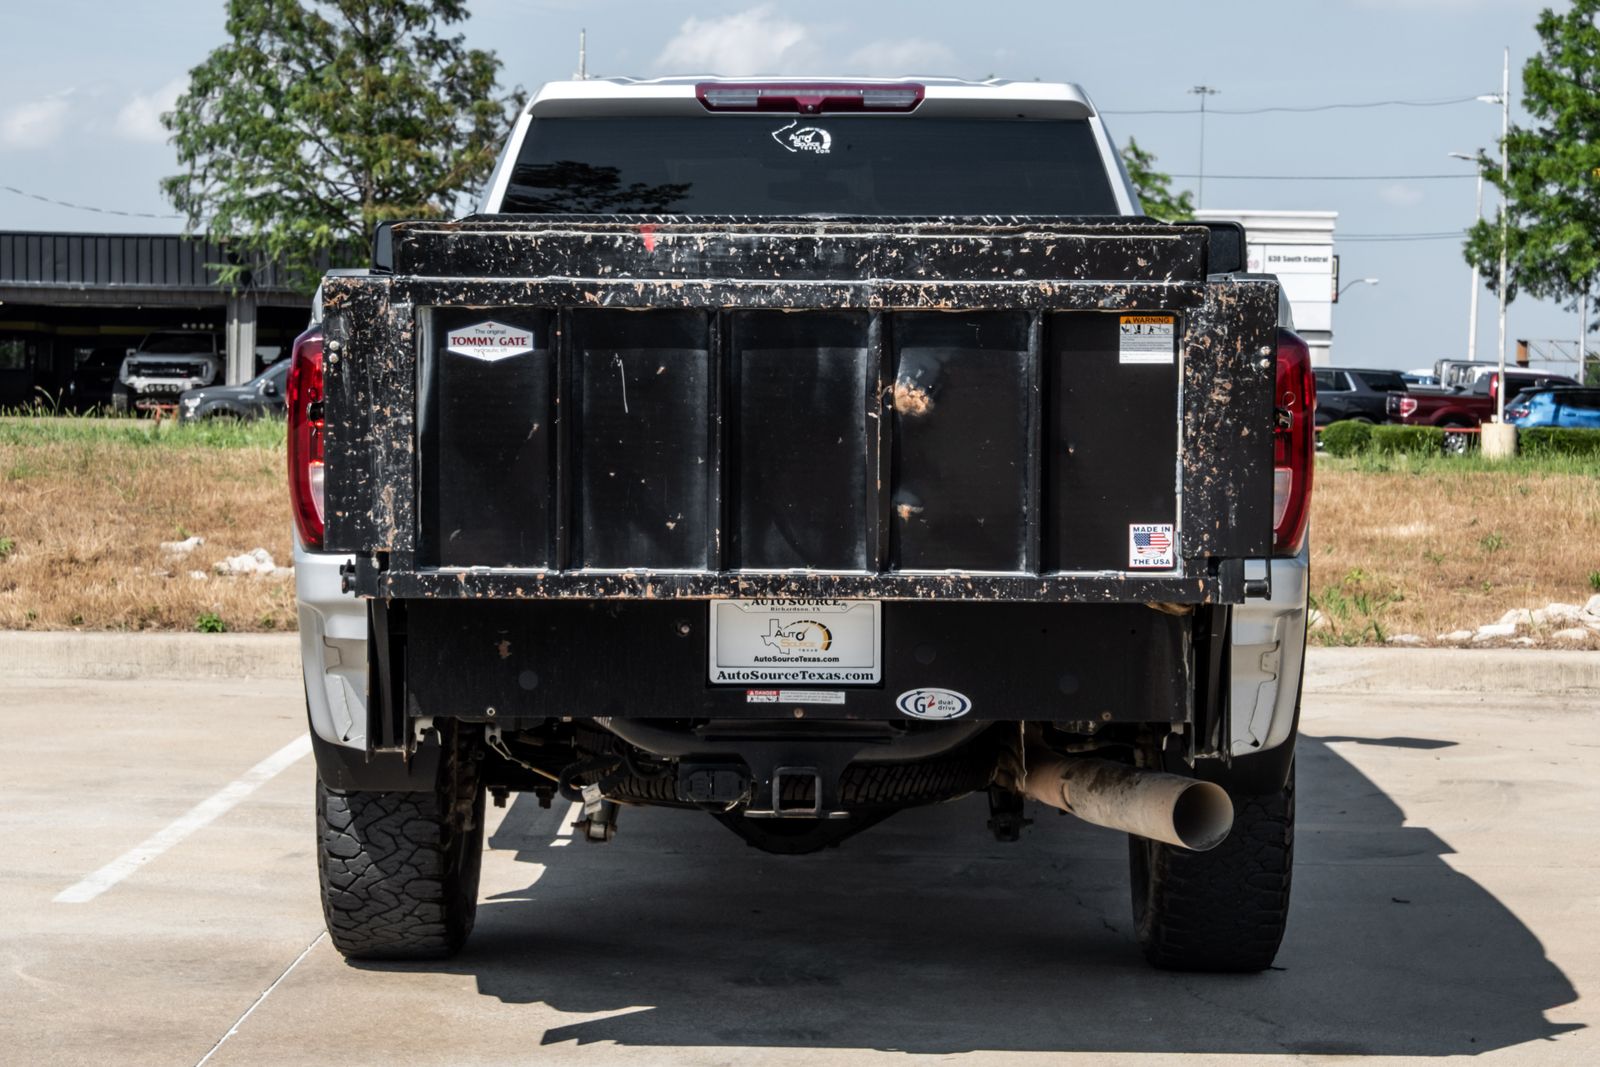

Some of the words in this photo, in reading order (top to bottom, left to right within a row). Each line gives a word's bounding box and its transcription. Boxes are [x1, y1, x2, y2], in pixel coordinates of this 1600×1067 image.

[1132, 316, 1170, 324] WARNING
[451, 337, 495, 346] TOMMY
[499, 337, 528, 346] GATE
[717, 671, 874, 681] AutoSourceTexas.com
